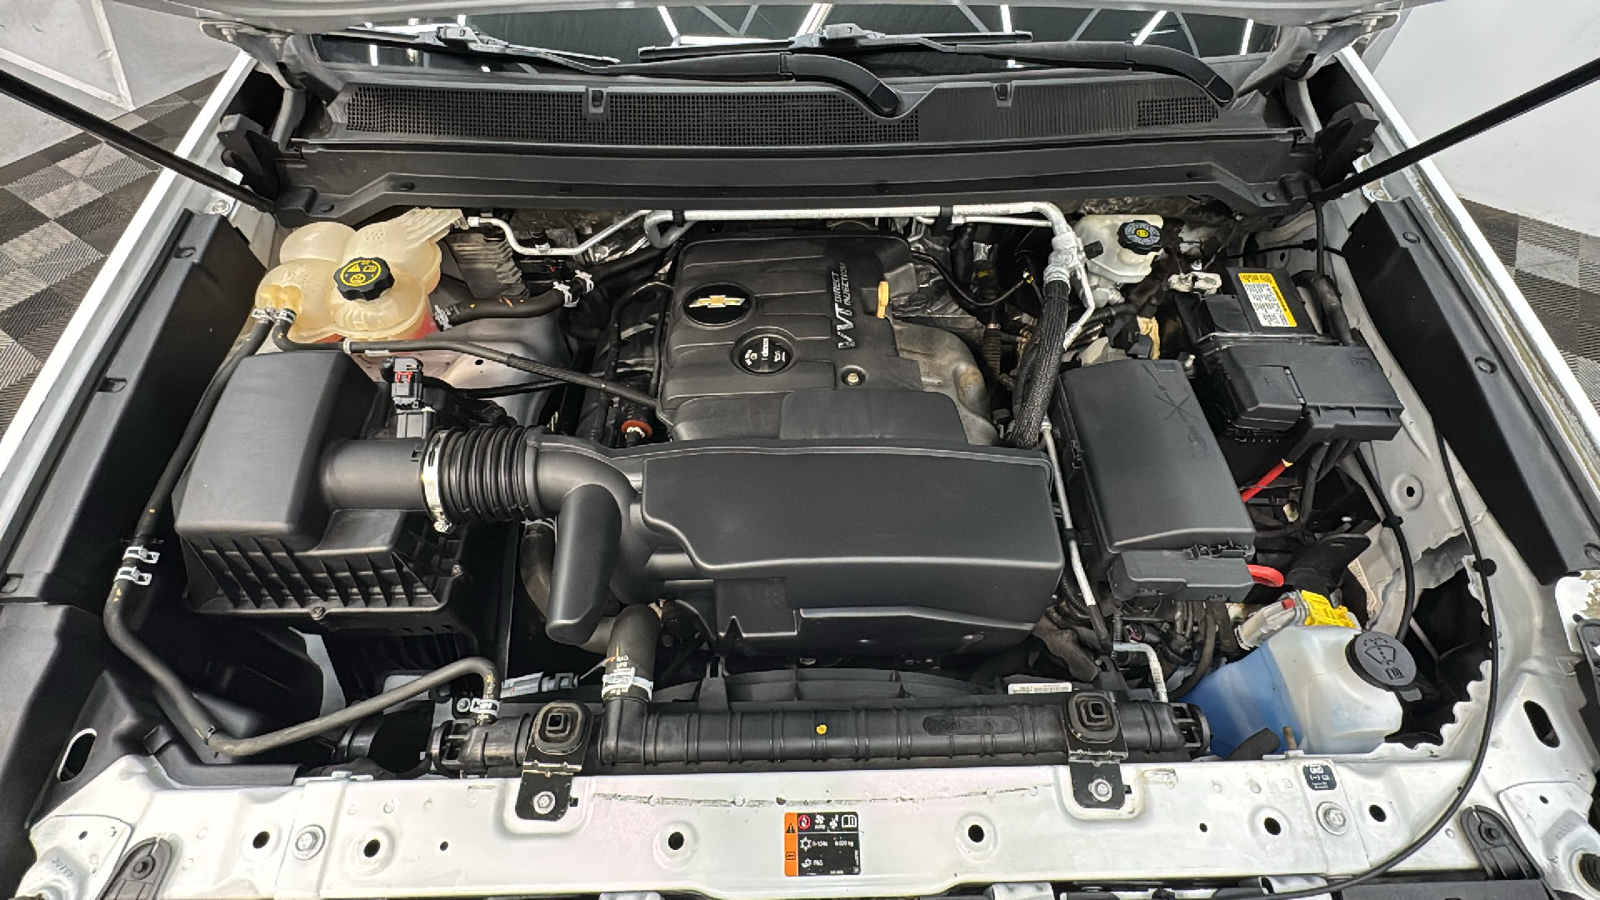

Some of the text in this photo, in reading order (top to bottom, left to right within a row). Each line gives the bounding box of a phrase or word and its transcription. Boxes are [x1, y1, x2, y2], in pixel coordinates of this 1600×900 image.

[832, 269, 842, 303] DIRECT
[840, 263, 851, 306] INJECTION
[837, 303, 855, 348] VVT
